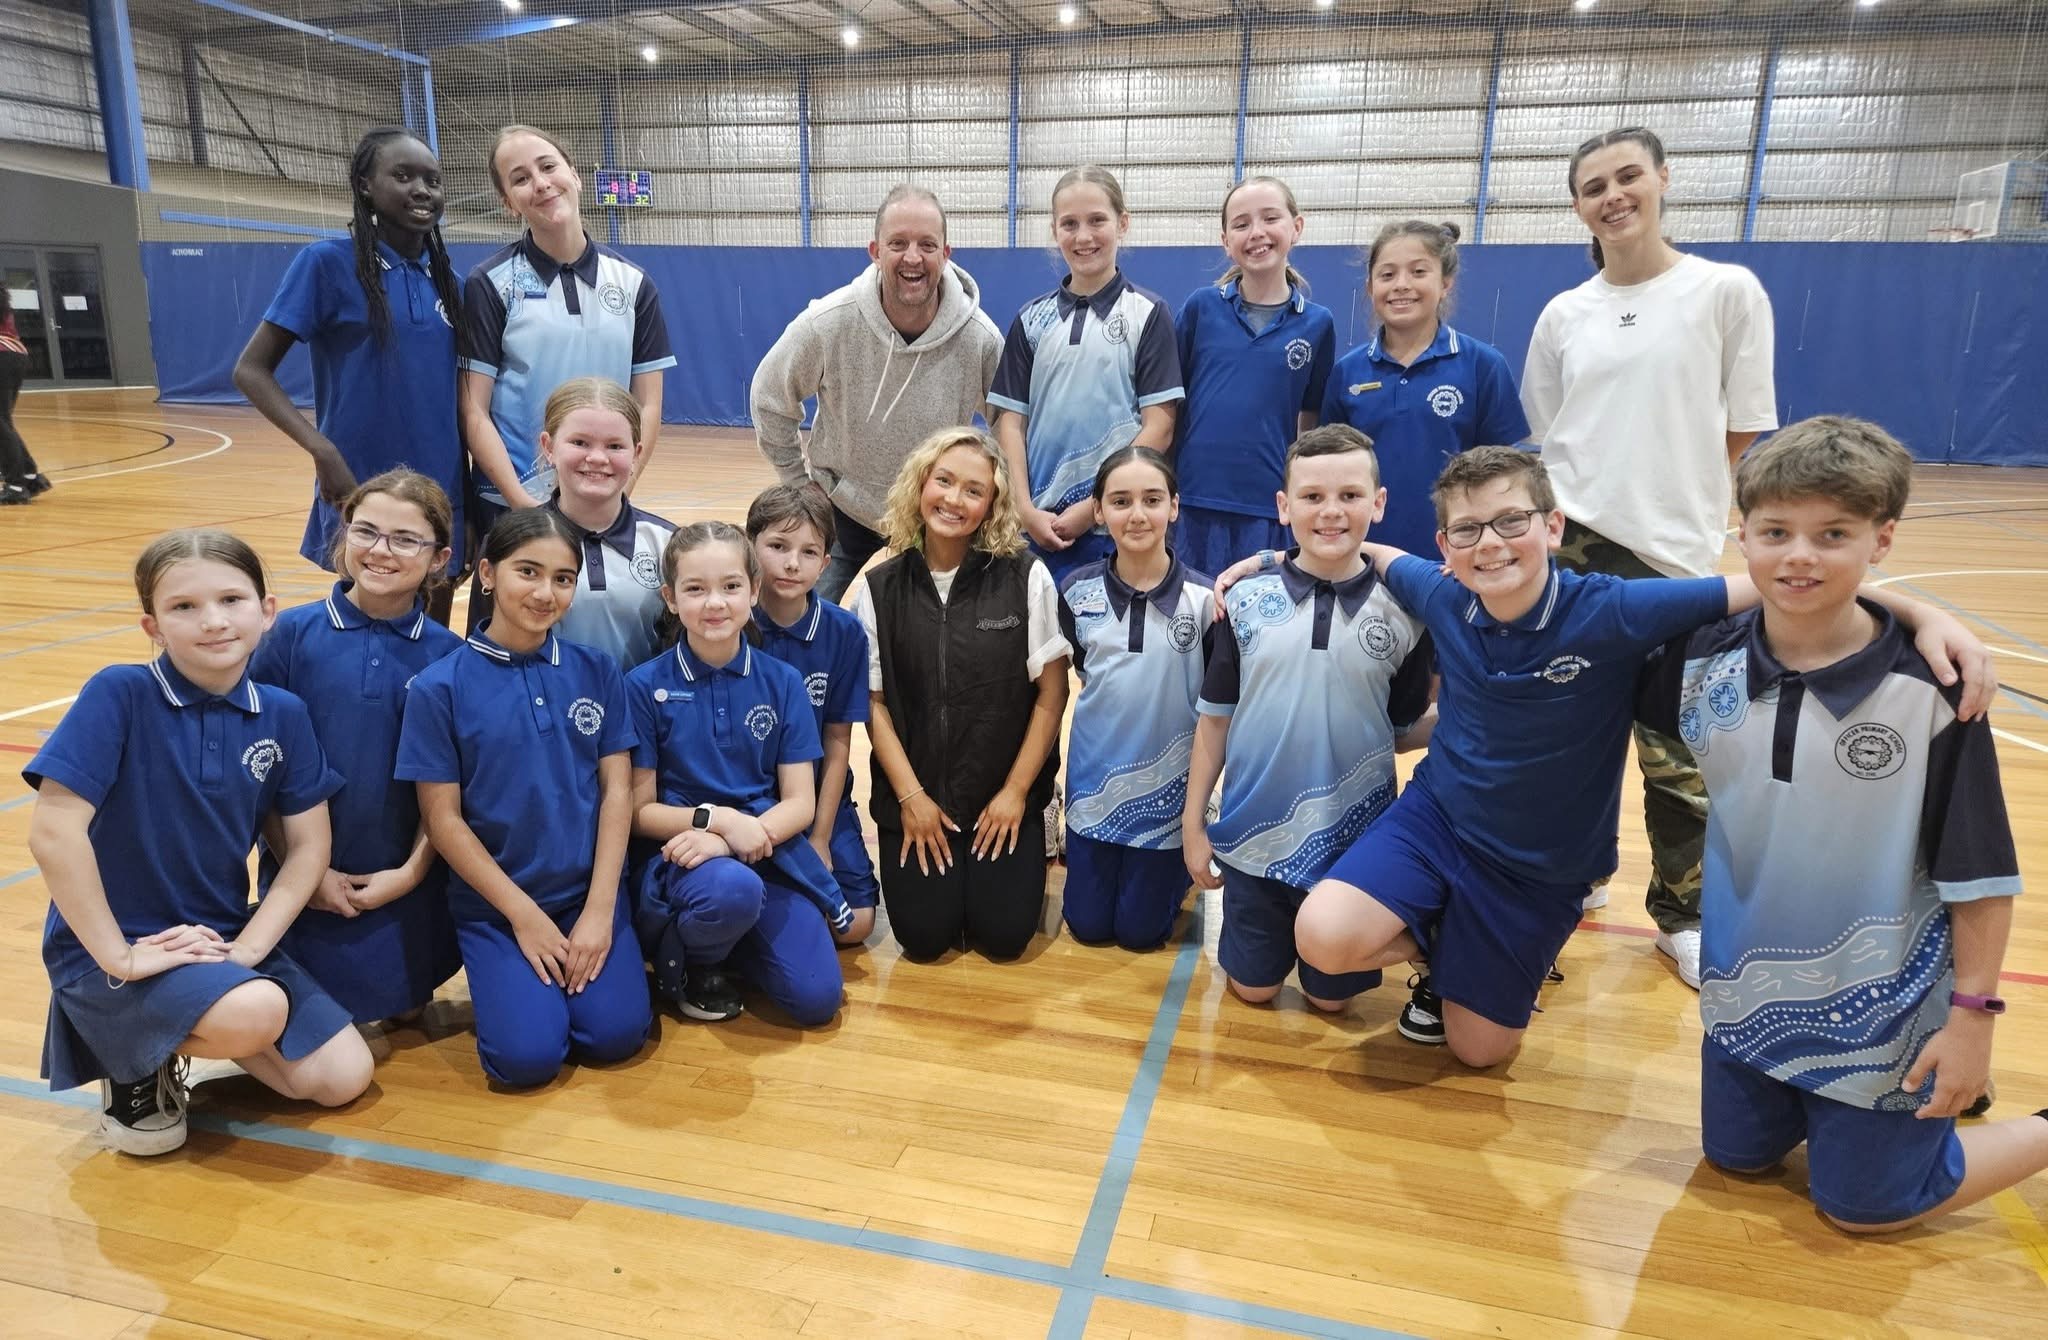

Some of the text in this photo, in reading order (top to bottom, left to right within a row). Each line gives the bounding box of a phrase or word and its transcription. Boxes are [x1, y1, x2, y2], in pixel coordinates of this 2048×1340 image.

[603, 194, 616, 203] 38
[635, 195, 648, 204] 32
[1839, 728, 1860, 746] OFFICER
[1860, 726, 1889, 736] PRIMARY
